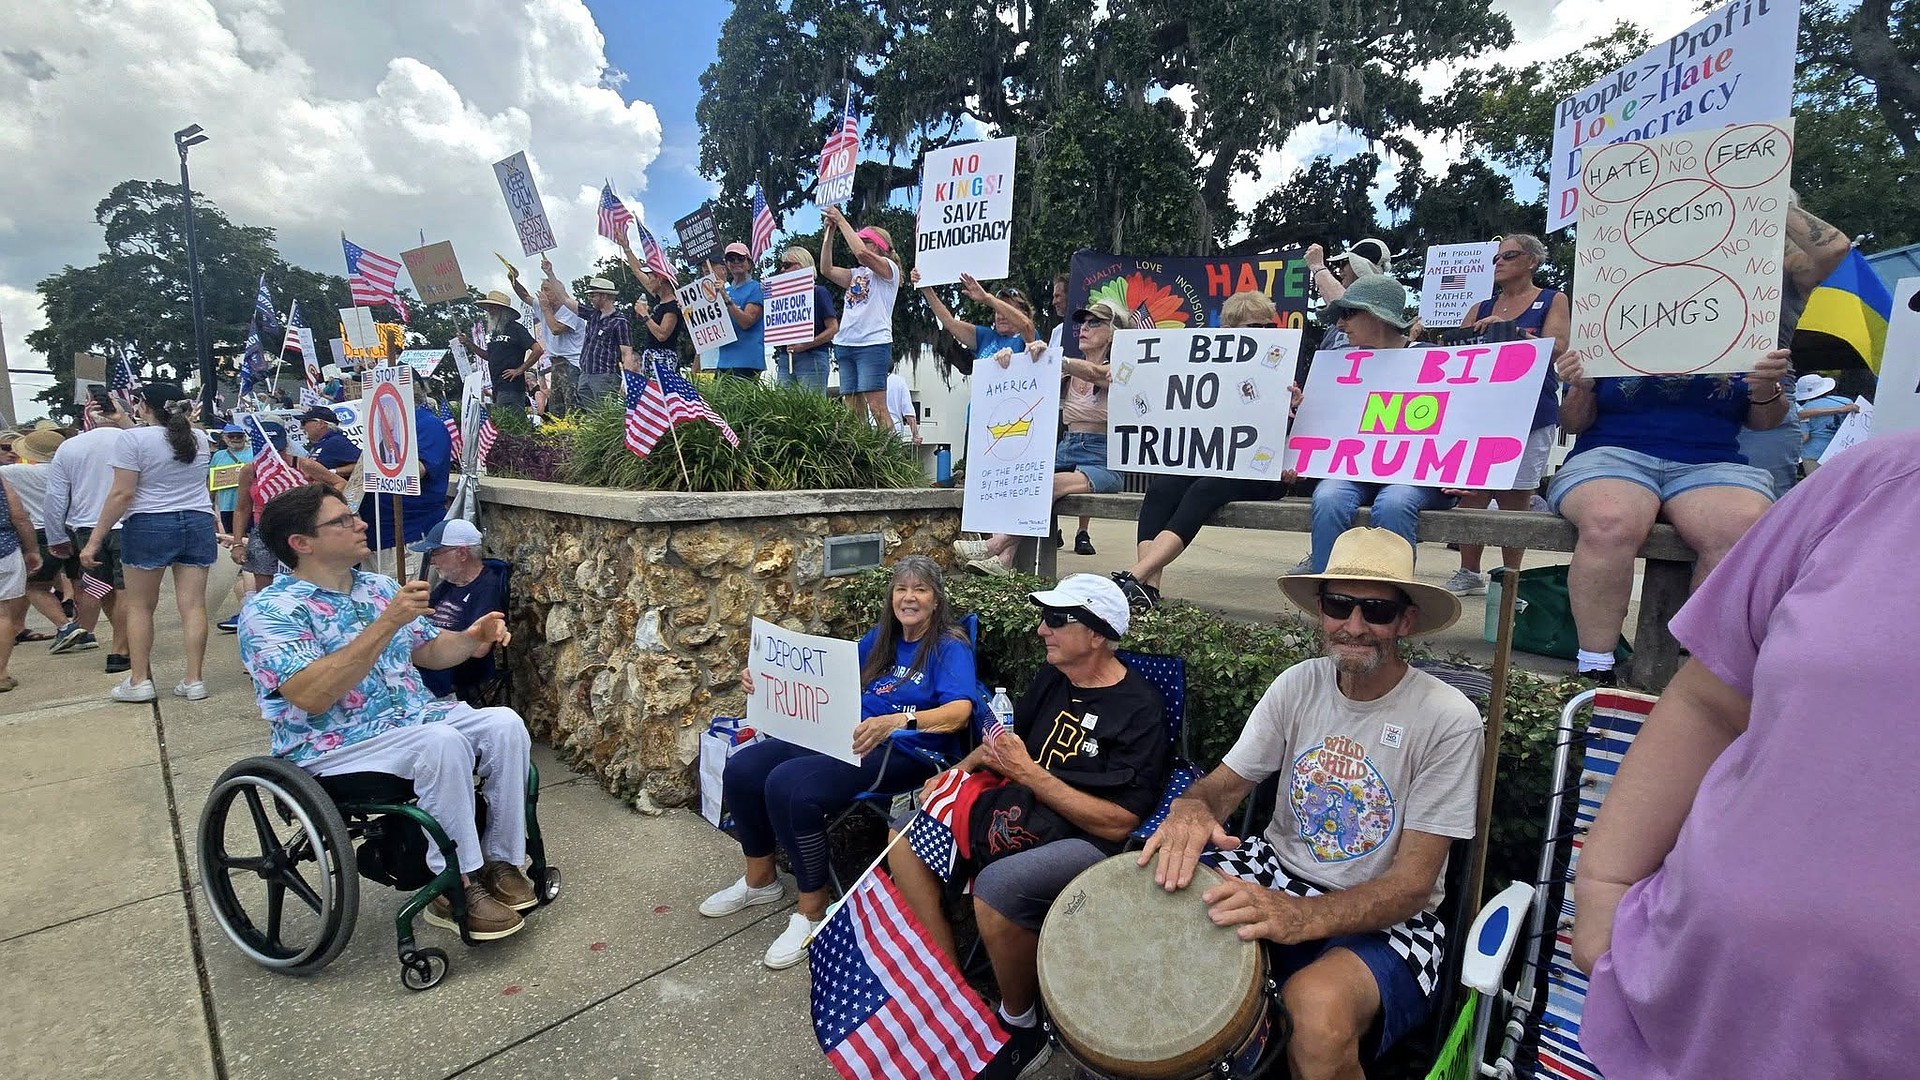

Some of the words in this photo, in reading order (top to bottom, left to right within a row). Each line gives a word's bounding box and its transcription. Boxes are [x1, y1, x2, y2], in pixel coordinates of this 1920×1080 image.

[1559, 70, 1638, 129] People
[1667, 0, 1771, 69] Profit
[1572, 98, 1638, 149] Love
[1659, 47, 1734, 104] Hate
[1660, 139, 1693, 158] NO
[1717, 138, 1776, 164] FEAR
[827, 149, 850, 178] NO
[951, 154, 980, 177] NO
[1590, 157, 1652, 186] HATE
[1668, 156, 1697, 174] NO
[512, 187, 535, 209] CALM
[815, 175, 854, 205] KINGS
[935, 174, 1004, 203] KINGS!
[942, 200, 989, 225] SAVE
[1581, 203, 1609, 222] NO
[1633, 200, 1724, 230] FASCISM
[1742, 195, 1778, 214] NO
[518, 214, 546, 239] RESIST
[918, 219, 1013, 253] DEMOCRACY
[1593, 225, 1622, 243] NO
[1746, 217, 1779, 238] NO
[520, 229, 556, 255] FASCISM
[1720, 238, 1751, 259] NO
[1135, 259, 1163, 273] LOVE
[1578, 247, 1606, 267] NO
[1744, 256, 1777, 276] NO
[1204, 258, 1306, 298] HATE
[1427, 264, 1485, 275] AMERICAN
[1594, 265, 1628, 284] NO
[680, 283, 703, 307] NO!
[770, 297, 789, 313] SAVE
[789, 293, 807, 309] OUR
[1435, 292, 1474, 300] RATHER
[1575, 292, 1601, 315] NO
[1752, 285, 1780, 301] NO
[688, 302, 723, 329] KINGS
[765, 306, 812, 327] DEMOCRACY
[1618, 297, 1720, 331] KINGS
[1751, 310, 1776, 328] NO
[694, 320, 727, 346] EVER!
[1577, 321, 1601, 339] NO
[1136, 337, 1161, 364] I
[1187, 333, 1259, 364] BID
[1579, 344, 1604, 362] NO
[1741, 333, 1772, 351] NO
[1335, 351, 1375, 385] I
[1416, 342, 1538, 384] BID
[375, 367, 396, 384] STOP
[985, 377, 1039, 397] AMERICA
[1165, 371, 1221, 411] NO
[1360, 392, 1440, 434] NO
[1113, 424, 1259, 472] TRUMP
[981, 469, 993, 478] OF
[995, 467, 1010, 476] THE
[1015, 460, 1046, 472] PEOPLE
[1287, 435, 1524, 487] TRUMP
[376, 477, 408, 493] FASCISM
[981, 481, 991, 490] BY
[994, 478, 1009, 487] THE
[1012, 472, 1044, 484] PEOPLE
[980, 493, 994, 502] FOR
[995, 491, 1007, 499] THE
[1009, 486, 1040, 498] PEOPLE
[764, 635, 828, 678] DEPORT
[760, 671, 831, 725] TRUMP
